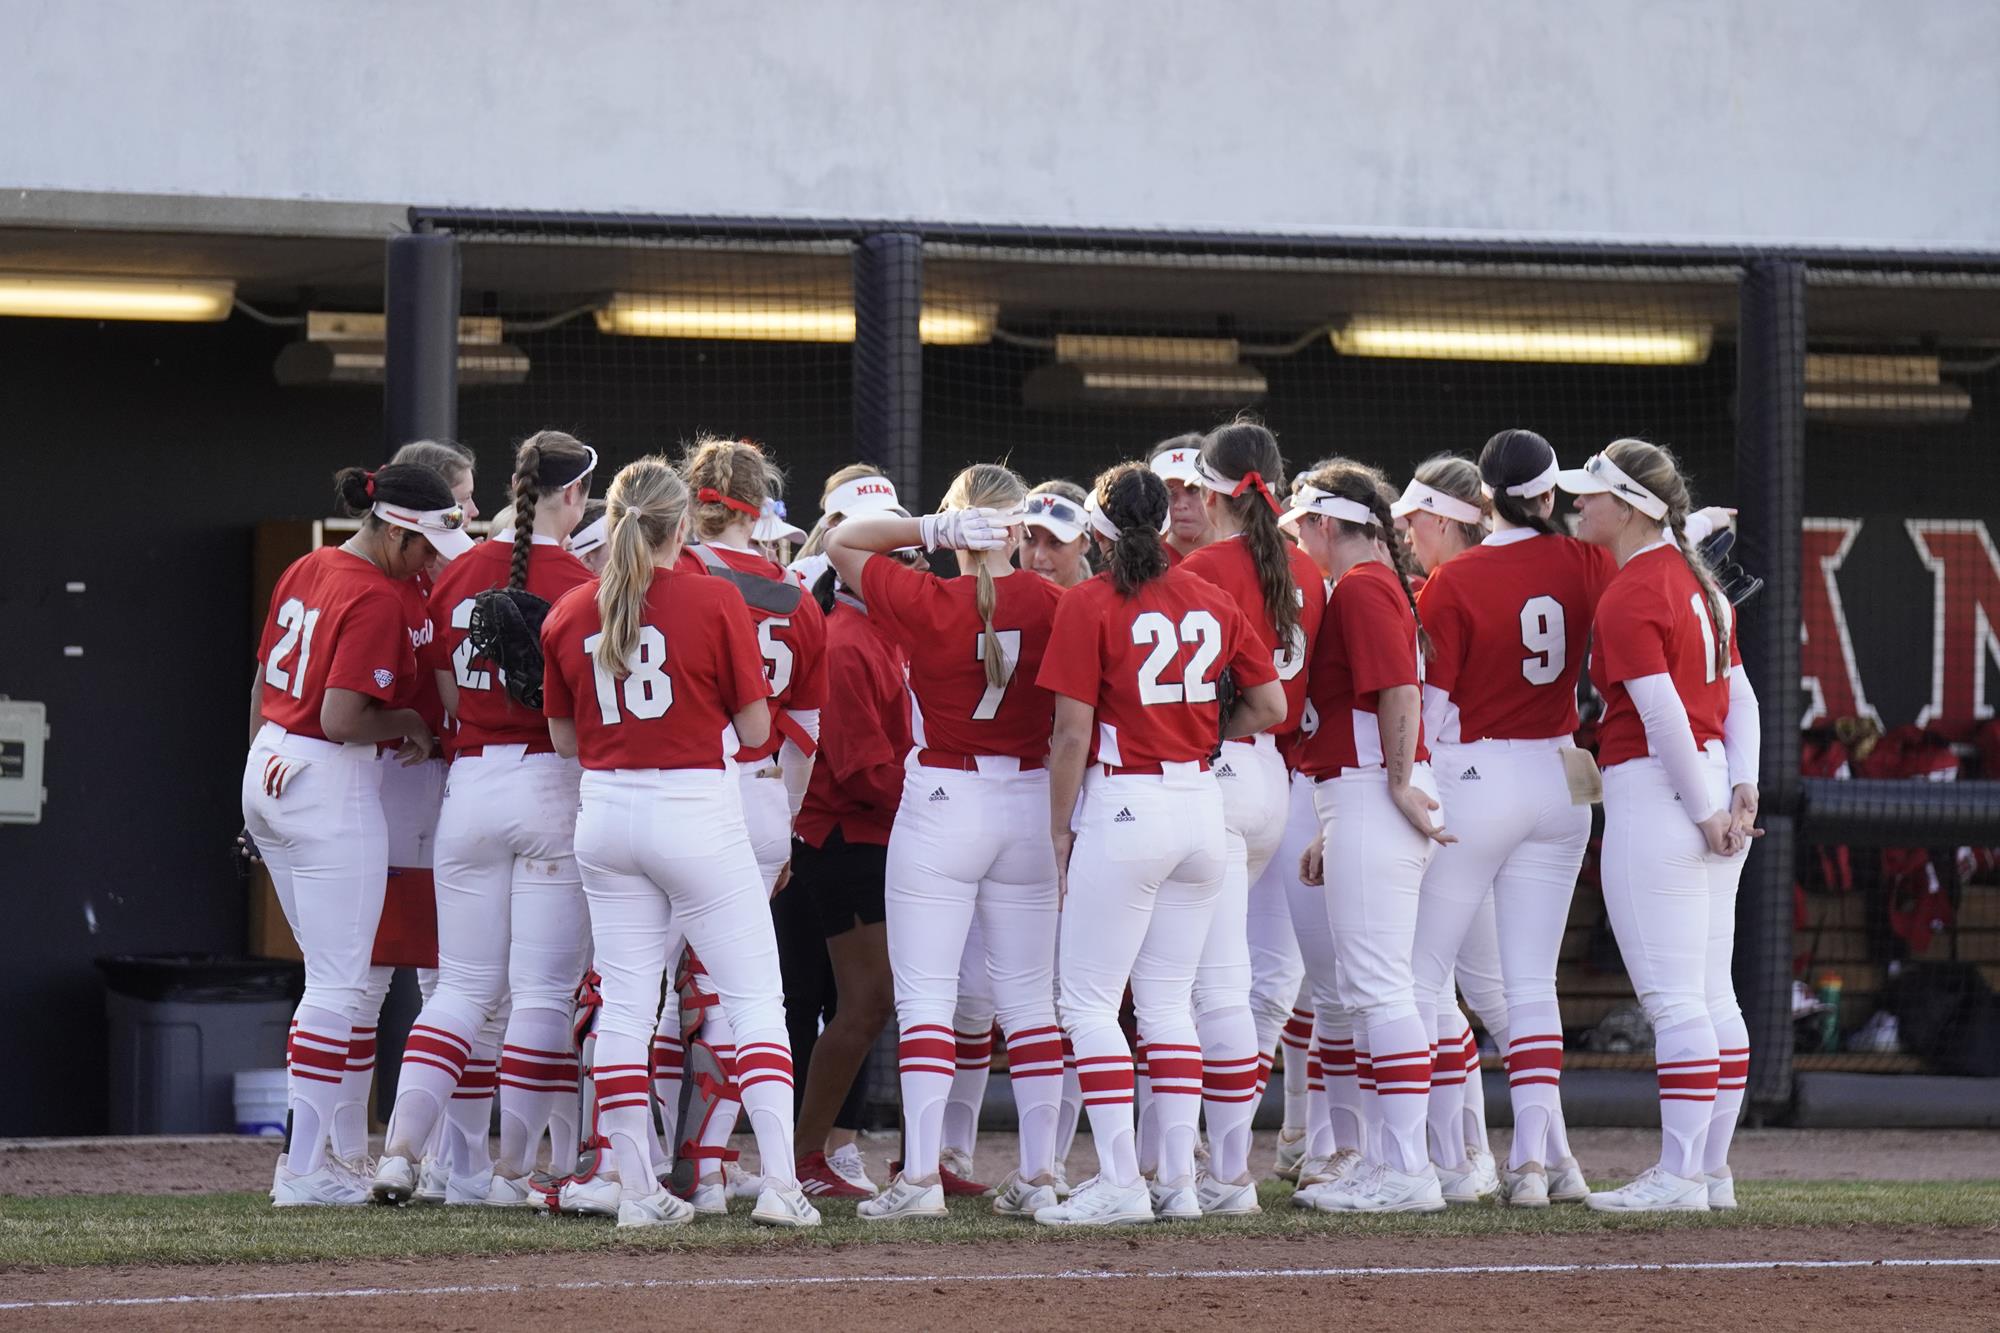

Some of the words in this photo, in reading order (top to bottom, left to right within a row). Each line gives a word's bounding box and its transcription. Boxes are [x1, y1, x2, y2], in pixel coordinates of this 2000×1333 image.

[1043, 496, 1055, 507] M
[1172, 452, 1184, 463] M
[266, 597, 321, 700] 21
[583, 624, 674, 726] 18
[971, 629, 1021, 721] 7
[1131, 609, 1223, 706] 22
[1519, 594, 1567, 686] 9
